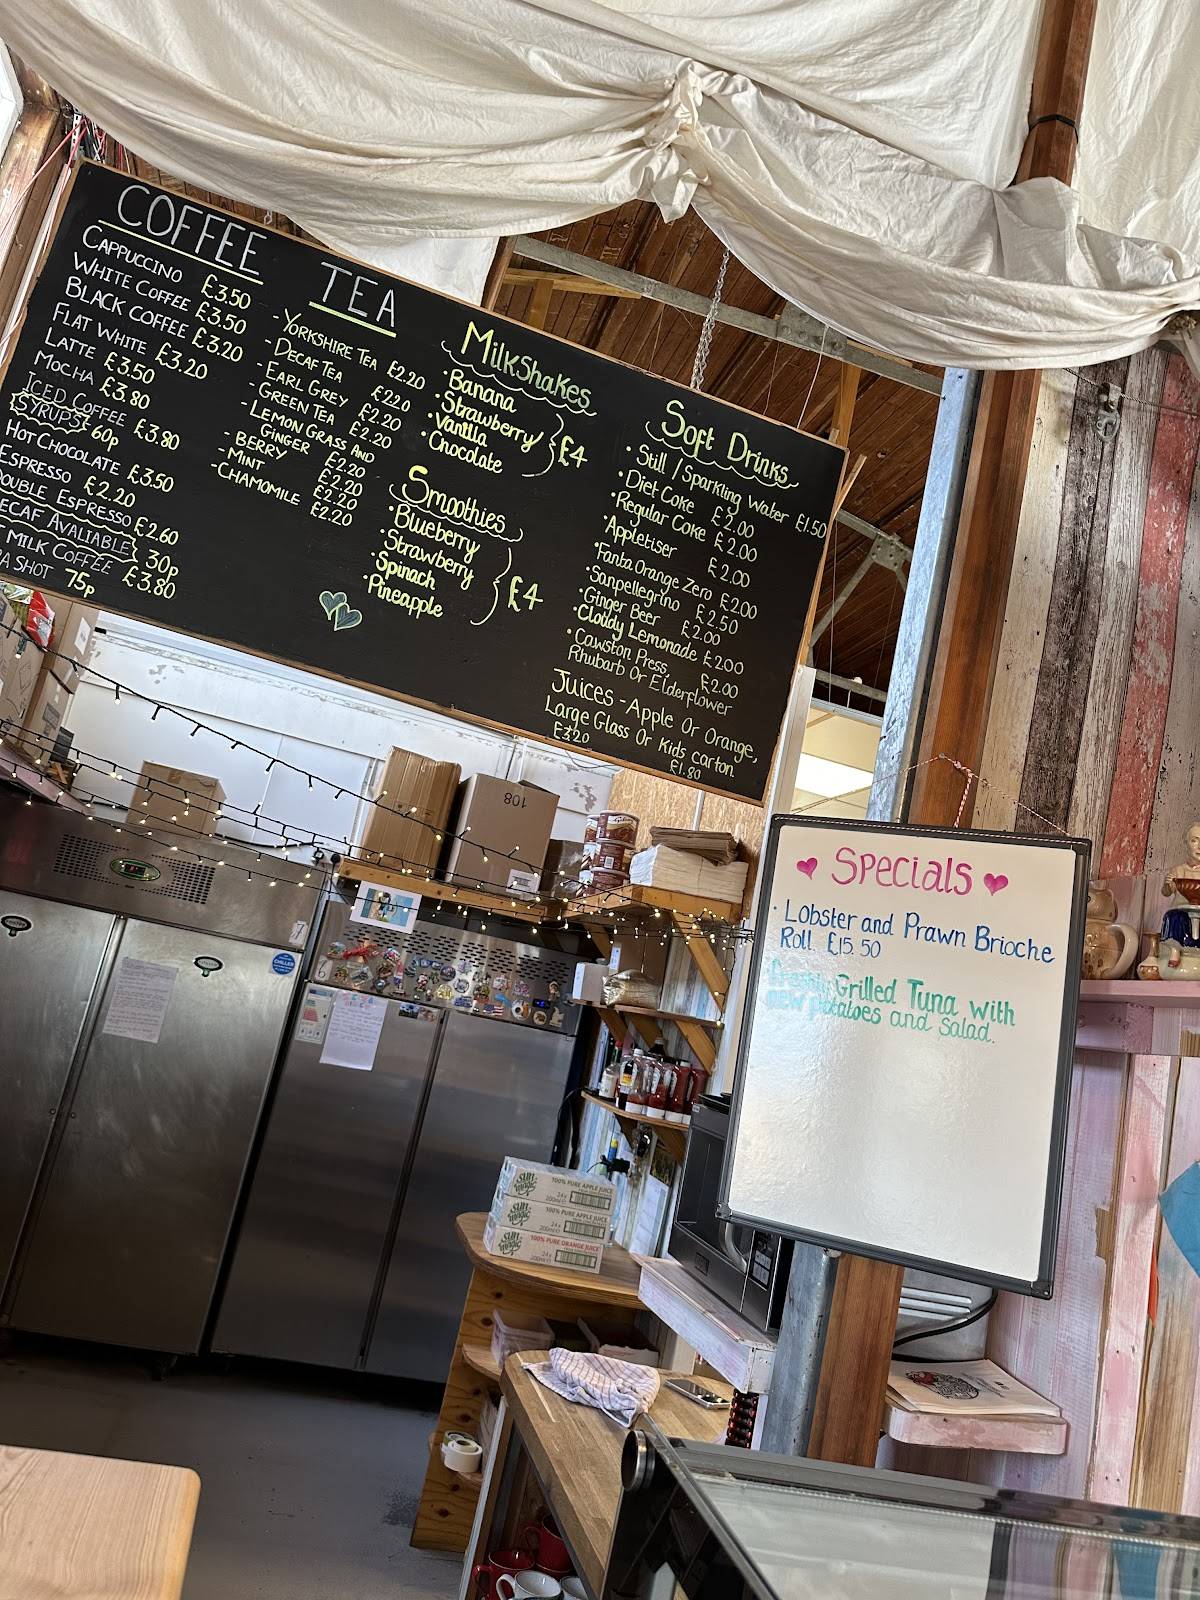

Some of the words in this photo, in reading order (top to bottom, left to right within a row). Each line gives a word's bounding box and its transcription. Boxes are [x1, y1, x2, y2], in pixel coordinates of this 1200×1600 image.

[118, 185, 267, 275] COFFEE
[74, 252, 130, 289] WHITE
[136, 280, 191, 311] COFFEE
[195, 301, 247, 335] £3.50
[82, 226, 182, 282] CAPPUCCINO
[201, 274, 251, 309] £3.50
[321, 262, 395, 328] TEA
[52, 302, 93, 332] FLAT
[98, 323, 147, 354] WHITE
[155, 343, 208, 379] £3.20
[65, 277, 126, 315] BLACK
[129, 306, 189, 339] COFFEE
[192, 327, 243, 361] £3.20
[283, 308, 353, 360] YORKSHIRE
[357, 348, 377, 370] TEA
[387, 360, 425, 390] £2.20
[34, 351, 94, 384] MOCHA
[99, 376, 150, 410] £3.80
[45, 327, 96, 359] LATTE
[103, 352, 155, 384] £3.50
[274, 338, 319, 370] DECAF
[322, 360, 343, 383] TEA
[23, 371, 66, 403] ICED
[73, 393, 127, 426] COFFEE
[134, 419, 180, 450] £3.80
[259, 382, 309, 414] GREEN
[313, 404, 335, 425] TEA
[349, 421, 392, 449] £2.20
[266, 361, 304, 392] EARL
[308, 380, 349, 407] GREY
[358, 403, 401, 431] £2.20
[441, 391, 544, 453] Strawberry
[449, 369, 517, 413] Banana
[15, 395, 81, 428] SYRUPS
[91, 425, 119, 451] 60p
[250, 400, 304, 433] LEMON
[305, 424, 347, 450] GRASS
[350, 444, 375, 463] AND
[428, 430, 503, 473] Chocolate
[436, 412, 487, 447] Vanilla
[558, 436, 588, 468] £4
[662, 400, 714, 457] Soft
[727, 432, 788, 483] Drinks
[0, 444, 71, 483] ESPRESSO
[84, 476, 135, 508] £2.20
[6, 419, 37, 444] HOT
[37, 433, 121, 475] CHOCOLATE
[127, 464, 174, 492] £3.50
[227, 447, 265, 470] MINT
[313, 485, 357, 510] £2.20
[235, 431, 287, 459] BERRY
[318, 468, 363, 497] £2.20
[325, 451, 365, 478] £2.20
[56, 489, 131, 527] ESPRESSO
[134, 517, 179, 545] £2.60
[217, 462, 300, 506] CHAMOMILE
[310, 501, 352, 526] £2.20
[402, 465, 506, 533] Smoothies
[626, 470, 658, 498] Diet
[661, 486, 695, 514] Coke
[711, 506, 754, 538] £2.00
[637, 444, 667, 475] Still
[795, 514, 827, 538] £1.50
[47, 513, 130, 555] AVALIABLE
[146, 549, 179, 582] 30p
[395, 503, 480, 564] Blueberry
[605, 515, 677, 559] Appletiser
[708, 557, 750, 588] £2.00
[616, 491, 669, 527] Regular
[672, 515, 706, 542] Coke
[714, 532, 757, 562] £2.00
[6, 530, 49, 555] MILK
[52, 543, 114, 575] COFFEE
[122, 566, 176, 599] £3.80
[13, 556, 54, 579] SHOT
[65, 568, 95, 598] 75p
[376, 551, 435, 590] Spinach
[384, 529, 474, 590] Strawberry
[597, 542, 633, 570] Fanta
[635, 560, 679, 594] Orange
[682, 577, 712, 600] Zero
[720, 593, 758, 619] £2.00
[368, 574, 443, 619] Pineapple
[508, 576, 543, 612] £4
[584, 586, 627, 618] Ginger
[630, 604, 661, 626] Beer
[681, 620, 720, 645] £2.00
[590, 565, 680, 611] Sanpellegrino
[696, 604, 738, 635] £2.50
[575, 628, 631, 660] Cawston
[701, 673, 738, 699] £2.00
[628, 622, 698, 661] Lemonade
[552, 668, 614, 706] Juices
[682, 718, 700, 737] Or
[568, 644, 625, 676] Rhubarb
[630, 667, 647, 683] Or
[649, 673, 733, 715] Elderflower
[545, 695, 589, 728] Large
[594, 712, 630, 738] Glass
[636, 729, 652, 746] Or
[657, 737, 686, 758] Kids
[504, 792, 527, 809] 108
[670, 759, 701, 779] £1.80
[831, 847, 973, 896] Specials
[785, 899, 858, 930] Lobster
[862, 913, 894, 935] and
[904, 912, 966, 948] Prawn
[974, 925, 1055, 964] Brioche
[836, 974, 896, 1004] Grilled
[907, 979, 958, 1016] Tuna
[890, 1009, 932, 1032] and
[568, 1179, 581, 1187] PURE
[582, 1182, 598, 1191] APPLE
[599, 1185, 612, 1193] JUICE
[576, 1212, 592, 1220] APPLE
